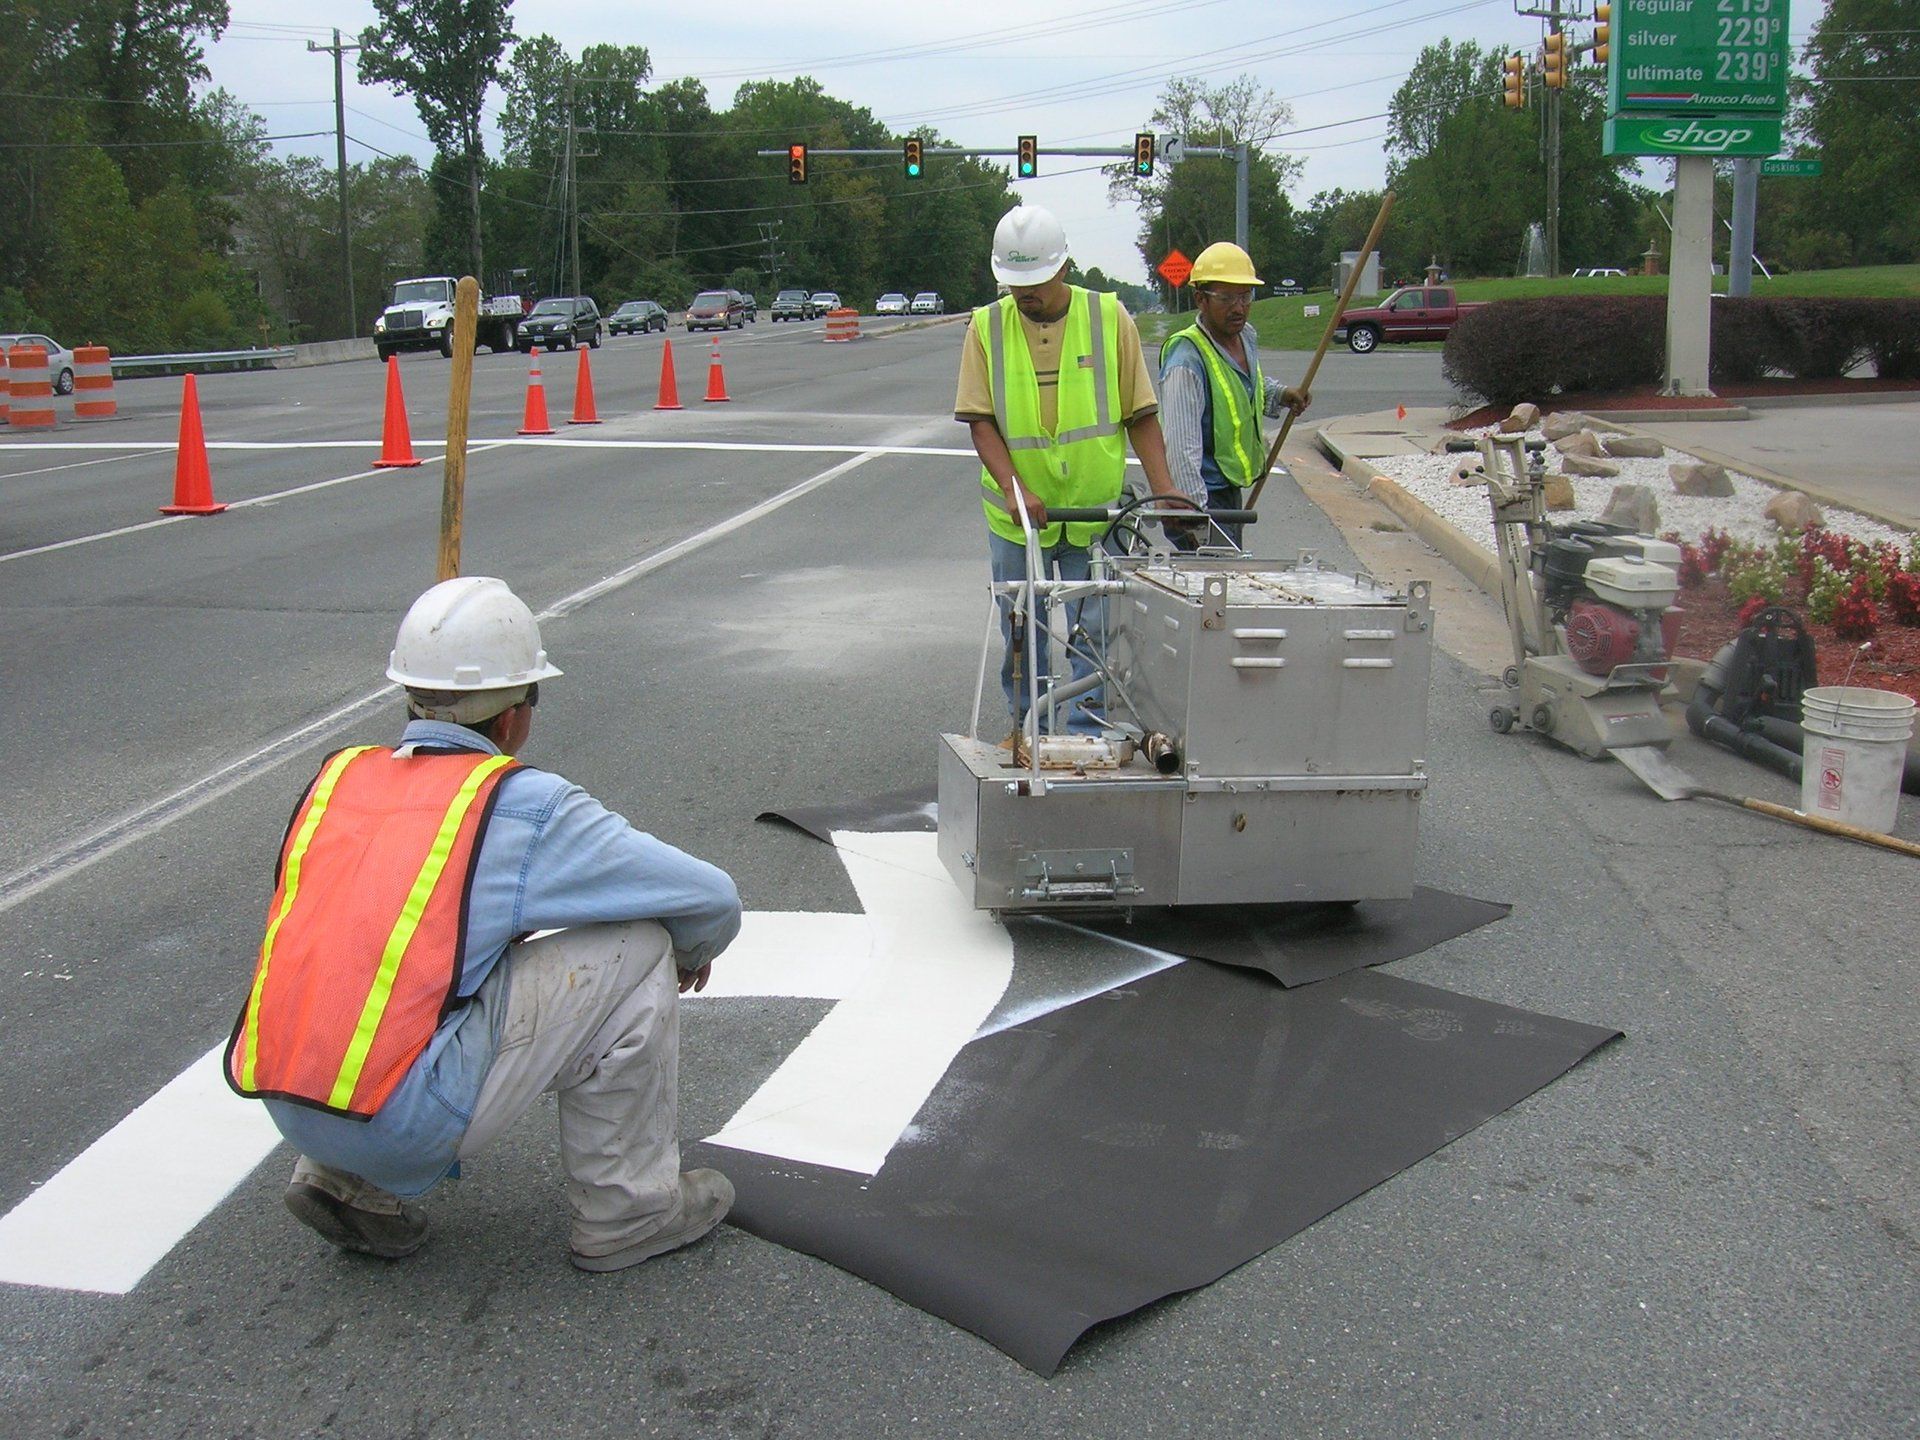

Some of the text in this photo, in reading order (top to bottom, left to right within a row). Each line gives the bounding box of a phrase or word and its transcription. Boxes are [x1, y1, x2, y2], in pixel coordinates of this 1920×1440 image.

[1628, 0, 1693, 15] regular
[1628, 30, 1677, 46] silver
[1716, 17, 1770, 47] 229
[1627, 65, 1703, 81] ultimate
[1715, 51, 1768, 81] 239
[1686, 93, 1776, 105] Amoco Fuels
[1660, 121, 1754, 151] shop
[1763, 161, 1801, 172] Gaskins
